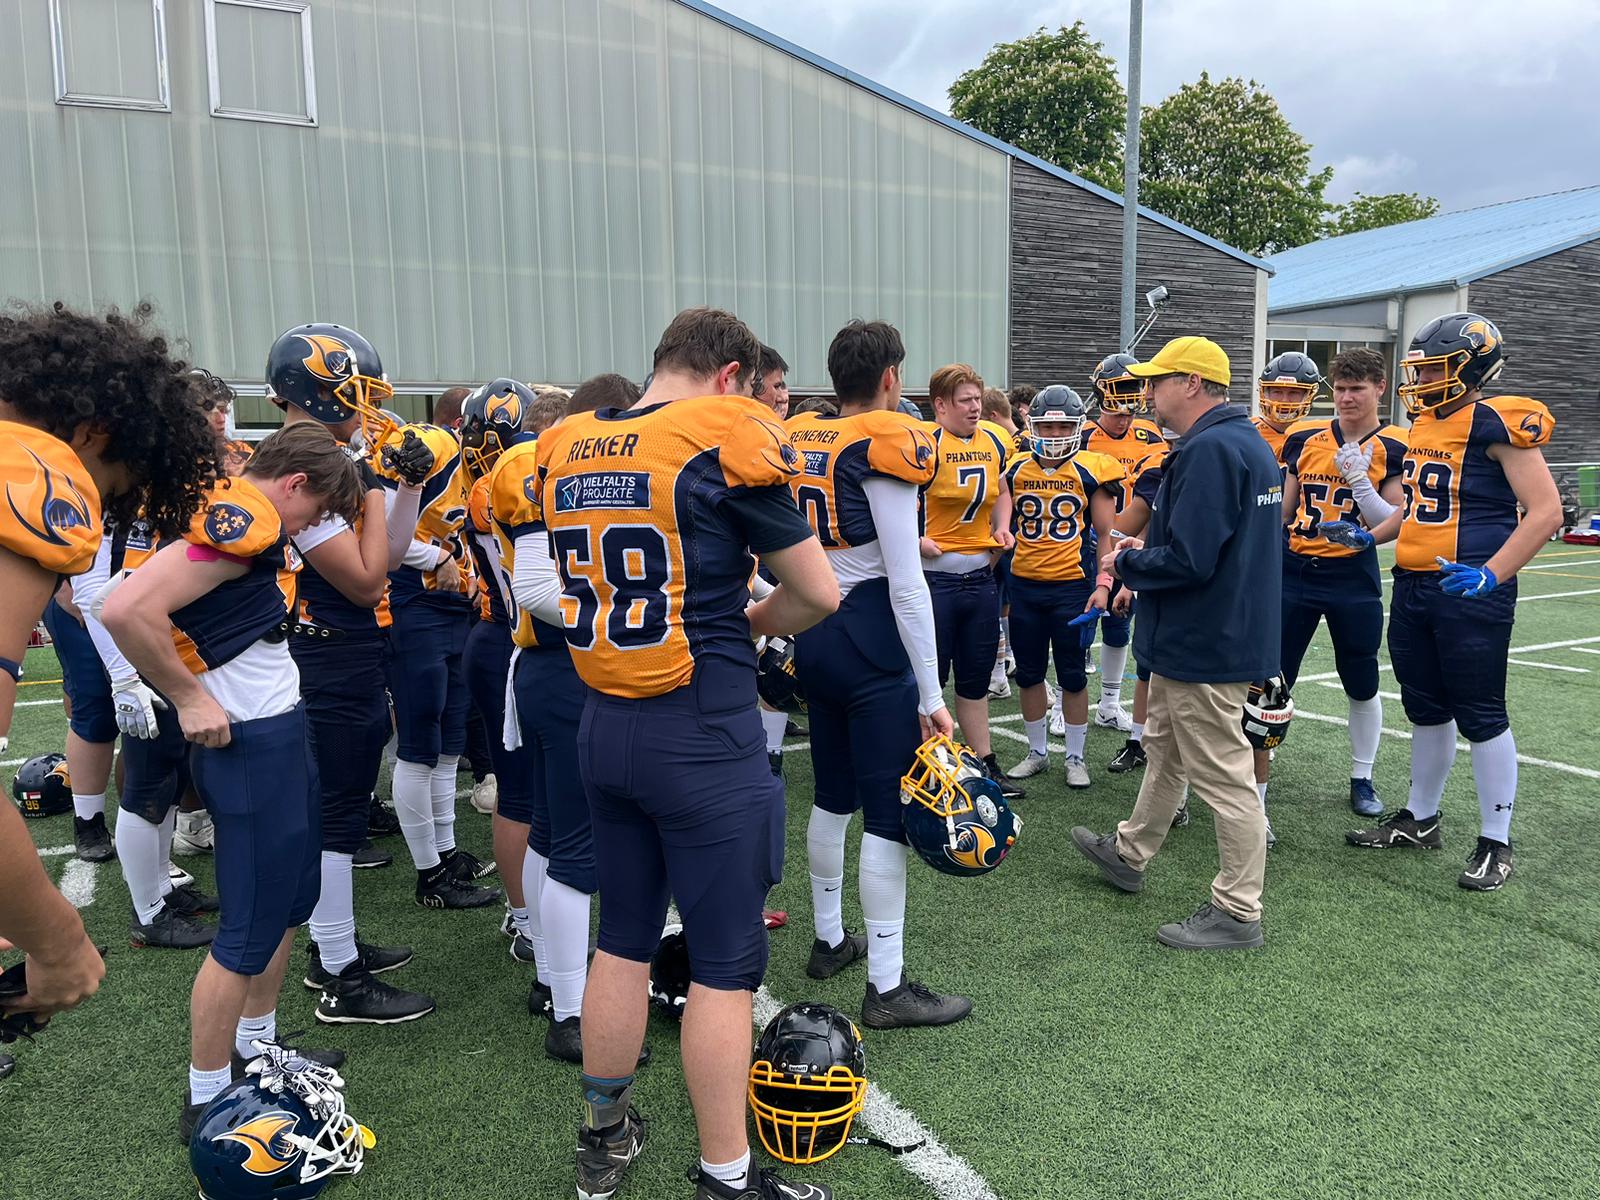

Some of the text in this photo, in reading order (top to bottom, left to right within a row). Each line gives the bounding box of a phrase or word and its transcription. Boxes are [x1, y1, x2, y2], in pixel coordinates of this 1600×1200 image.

[789, 429, 839, 445] REINEMER
[566, 433, 639, 464] RIEMER
[1408, 448, 1452, 460] HANTOMS
[946, 451, 992, 463] PHANTOMS
[582, 476, 636, 488] VIELFALTS
[1303, 473, 1347, 484] PHANTO
[1023, 480, 1074, 490] PHANTOMS
[582, 488, 635, 499] PROJEKTE
[957, 465, 987, 524] 7
[1015, 492, 1084, 542] 88
[552, 523, 673, 652] 58
[25, 800, 39, 810] 96
